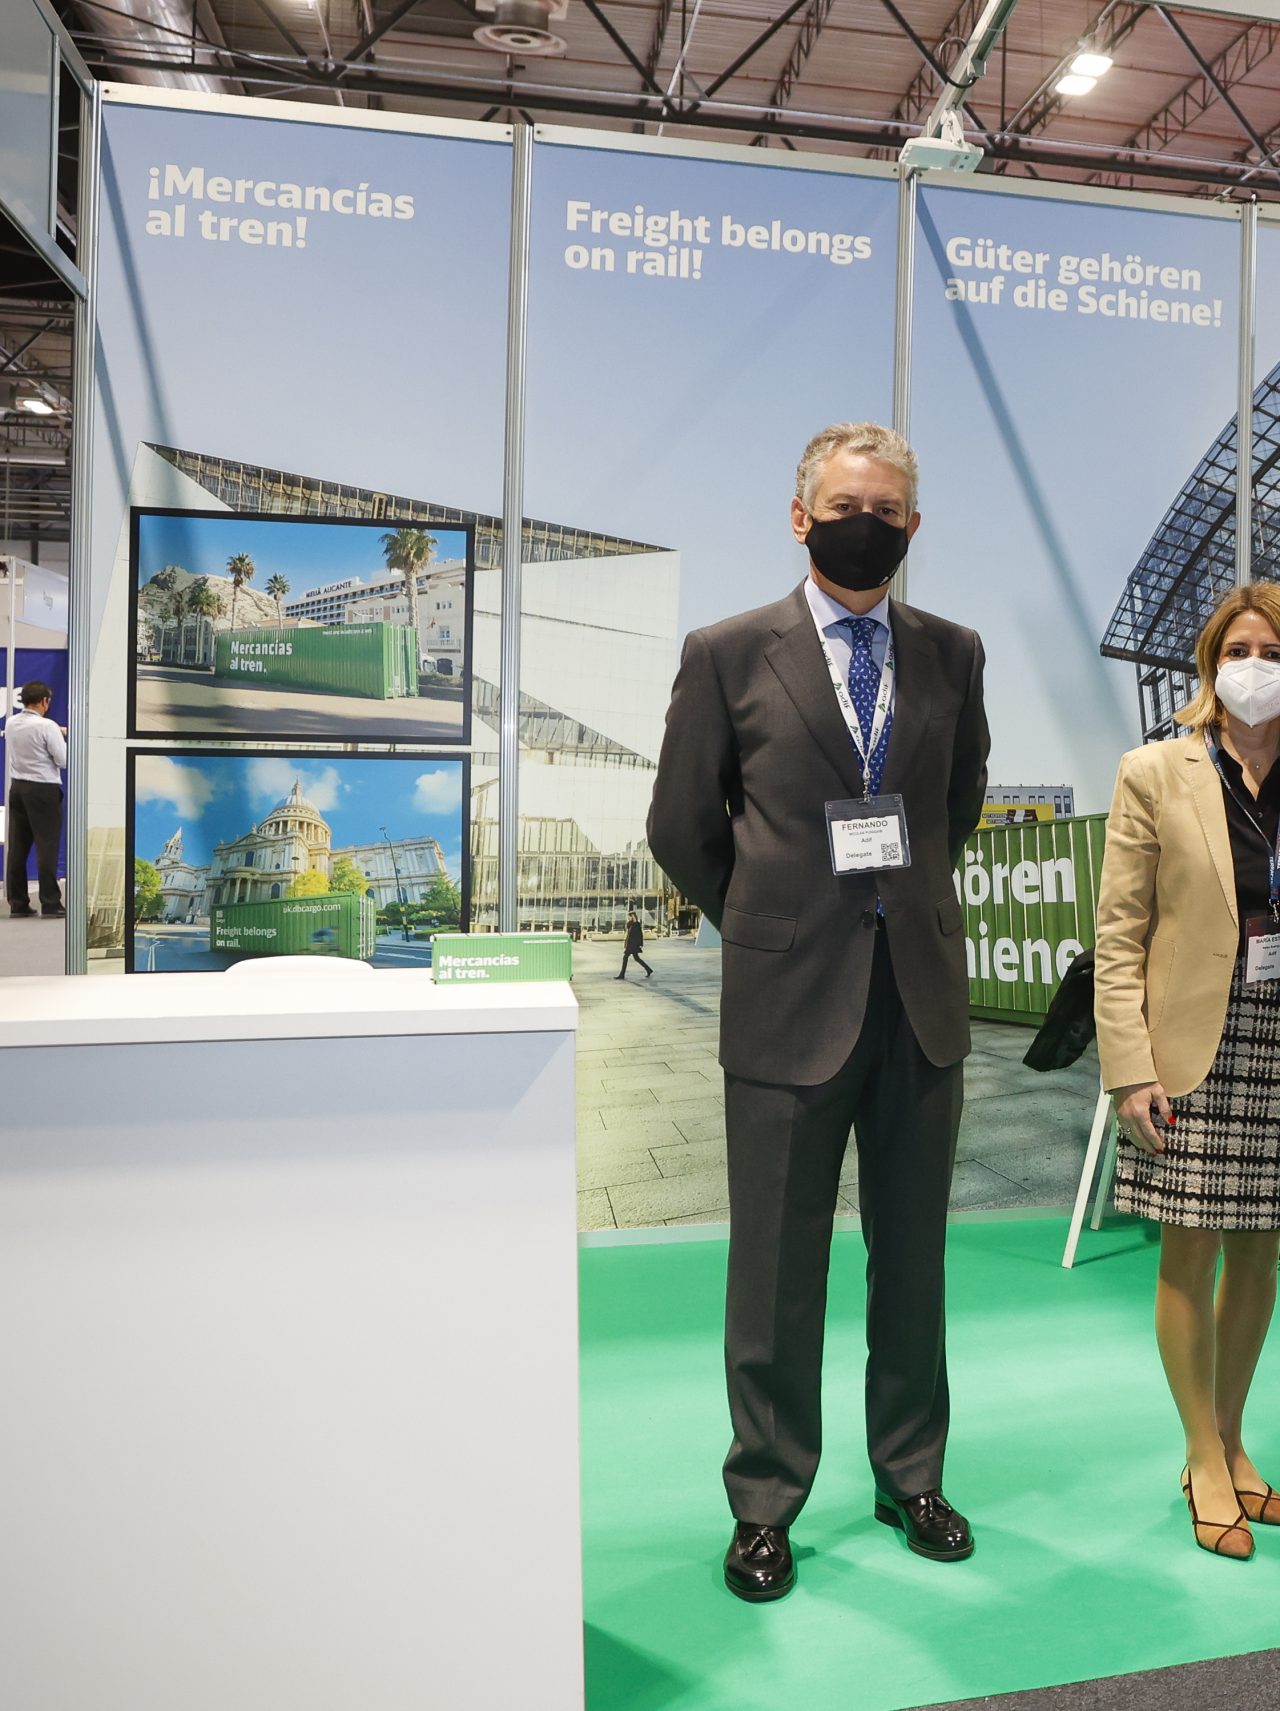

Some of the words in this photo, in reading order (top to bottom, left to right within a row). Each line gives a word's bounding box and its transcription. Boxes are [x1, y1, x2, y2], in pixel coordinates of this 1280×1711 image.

[148, 164, 415, 221] ¡Mercancías
[145, 205, 185, 238] al
[198, 208, 307, 249] tren!
[565, 200, 711, 247] Freight
[720, 215, 872, 264] belongs
[564, 243, 614, 272] on
[627, 242, 702, 279] rail!
[946, 237, 1049, 275] Güter
[1058, 254, 1201, 291] gehören
[945, 275, 1004, 304] auf
[1013, 279, 1068, 311] die
[1078, 285, 1222, 327] Schiene!
[231, 639, 293, 655] Mercancías
[230, 656, 238, 670] al
[240, 658, 267, 673] tren.
[842, 820, 888, 831] FERNANDO
[283, 903, 341, 914] uk.dbcargo.com
[216, 926, 241, 938] Freight
[243, 926, 277, 939] belongs
[216, 939, 225, 947] on
[439, 954, 520, 967] Mercancías
[439, 968, 452, 979] al
[455, 968, 490, 979] tren.
